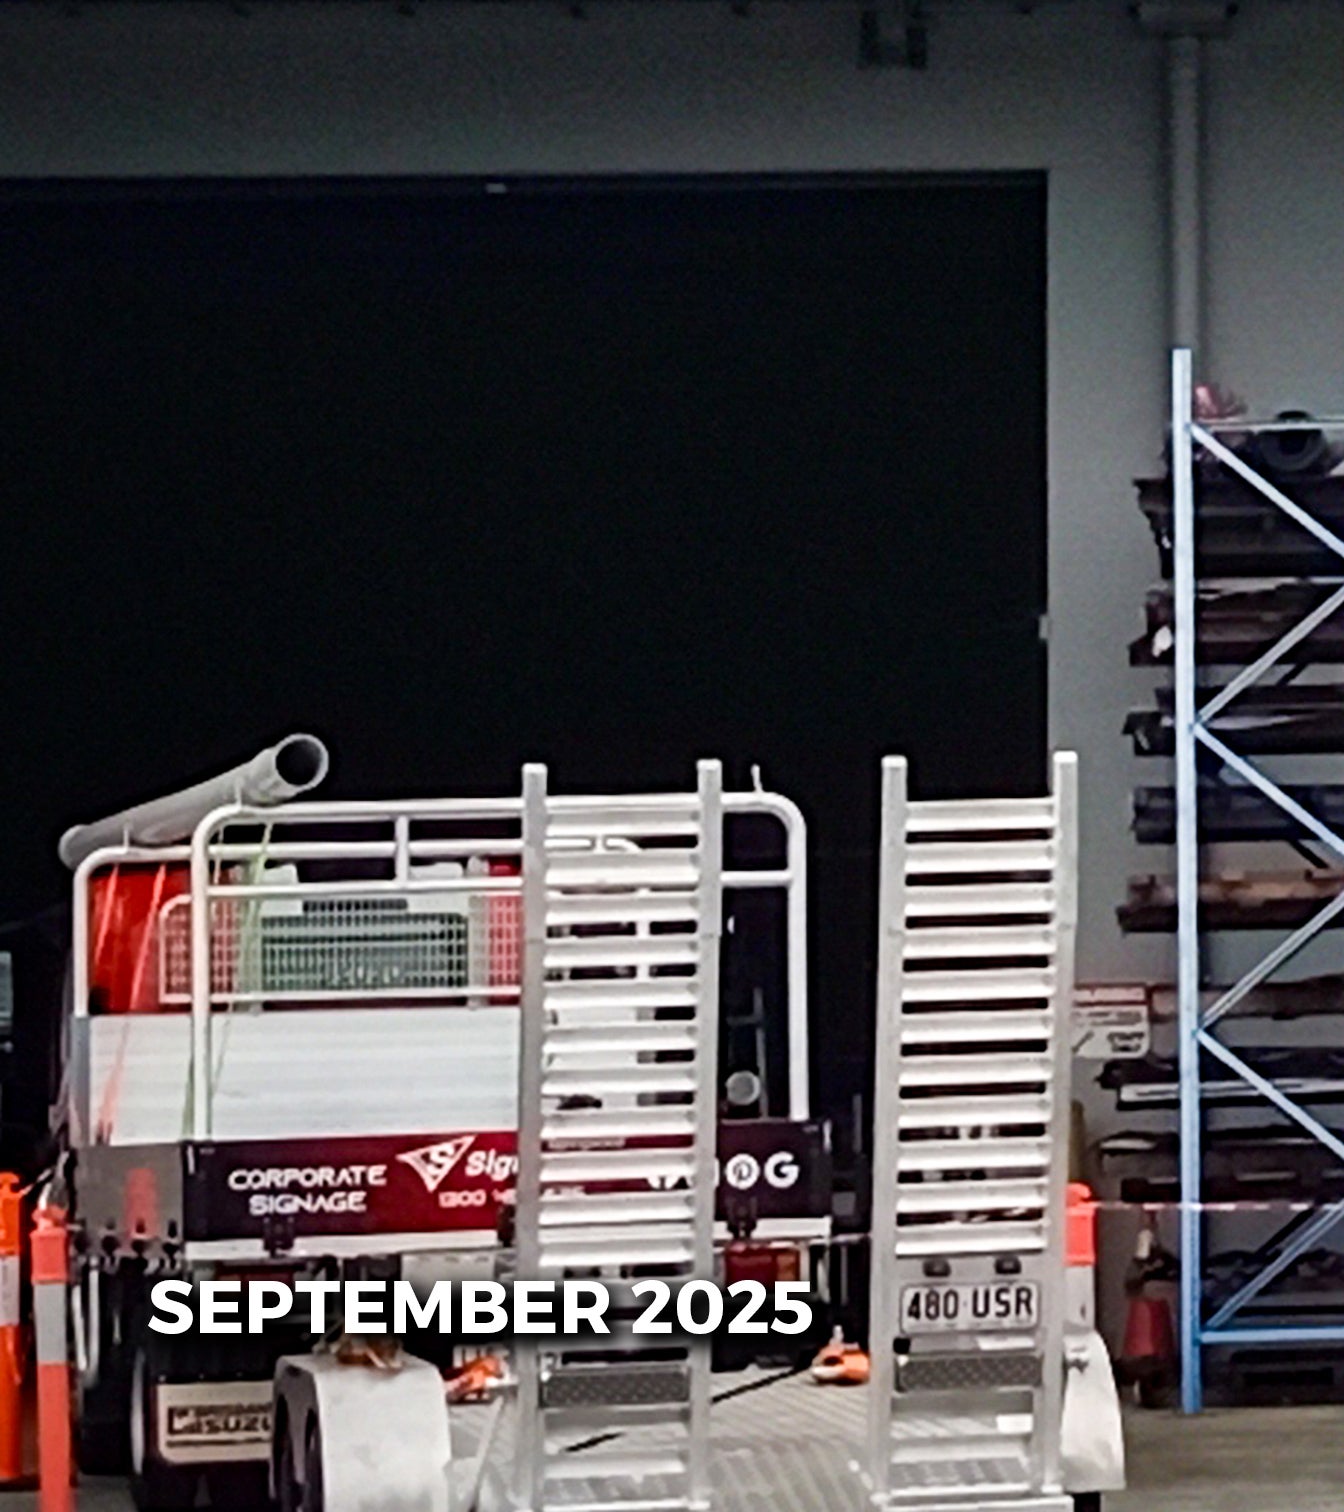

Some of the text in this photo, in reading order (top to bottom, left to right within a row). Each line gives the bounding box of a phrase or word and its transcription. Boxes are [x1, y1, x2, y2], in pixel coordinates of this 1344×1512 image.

[228, 1165, 387, 1190] CORPORATE
[249, 1191, 367, 1216] SIGNAGE
[907, 1286, 1033, 1321] 480 USR
